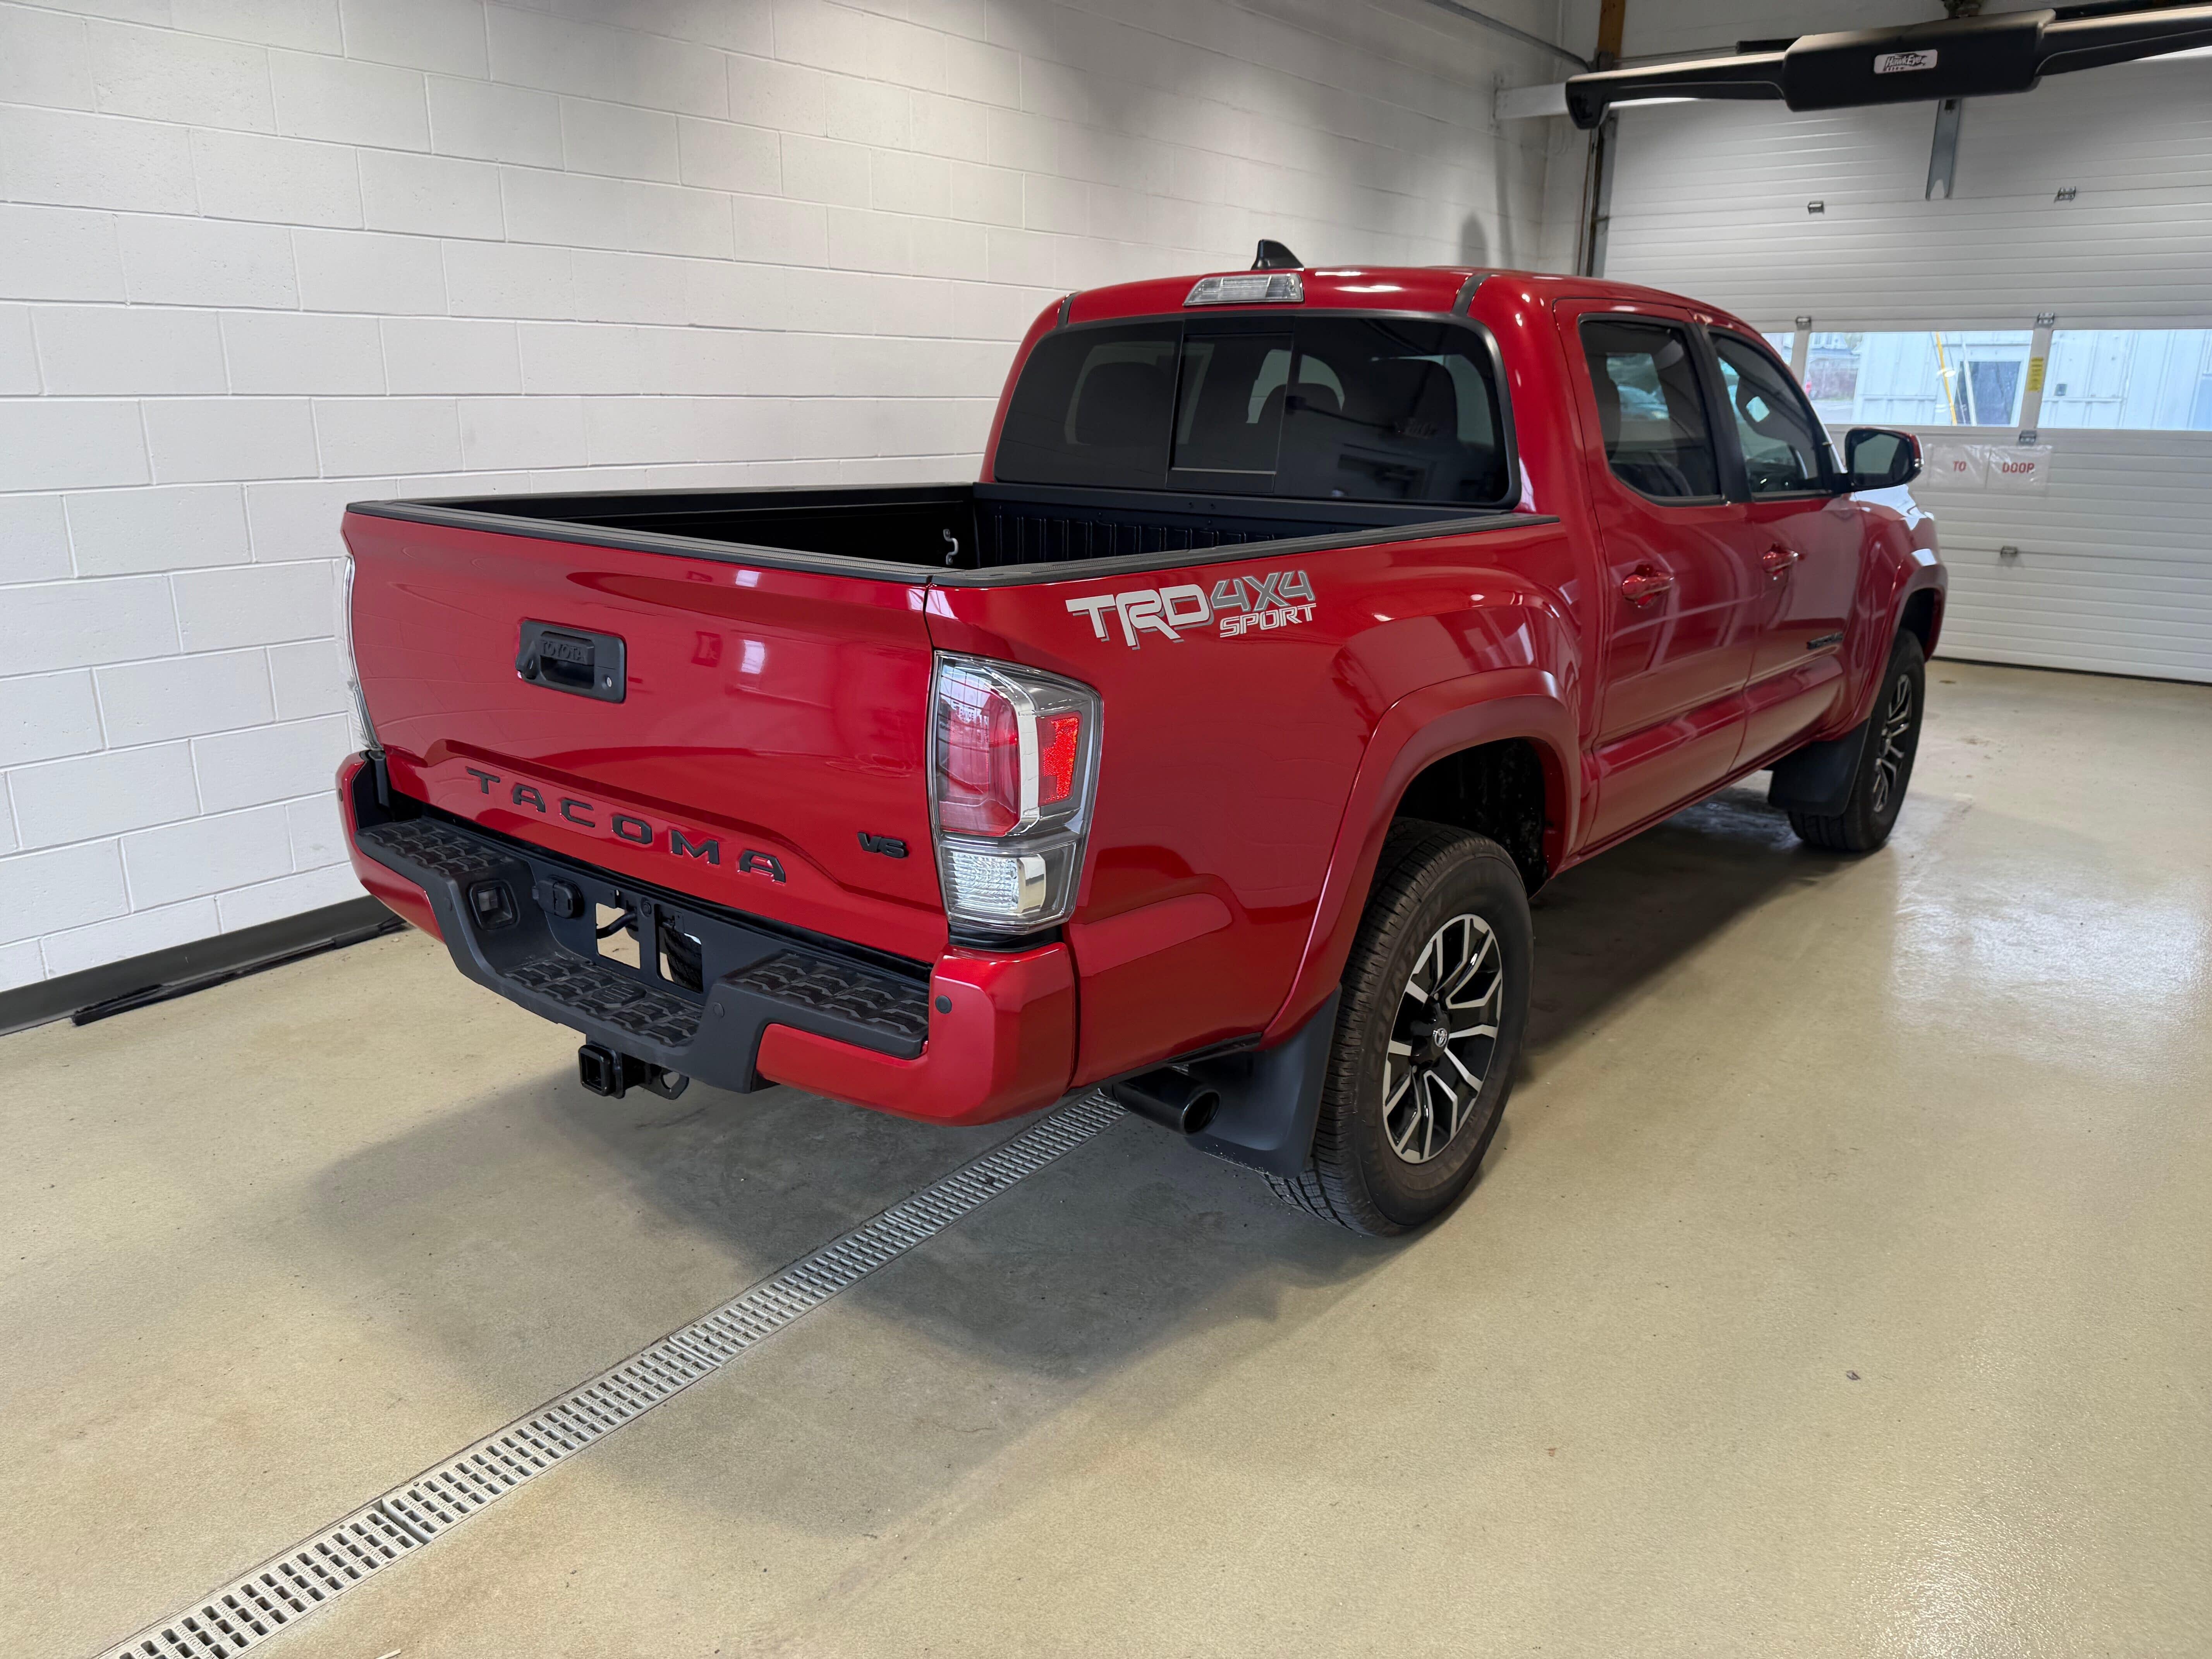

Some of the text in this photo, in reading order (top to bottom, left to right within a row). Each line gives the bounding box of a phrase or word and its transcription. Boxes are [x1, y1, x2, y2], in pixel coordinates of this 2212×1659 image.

[1953, 461, 1967, 472] TO
[1065, 584, 1214, 650] TRD
[1220, 603, 1316, 638] SPORT
[541, 640, 587, 661] TOYOTA
[467, 767, 787, 884] TACOMA
[857, 831, 909, 859] V6
